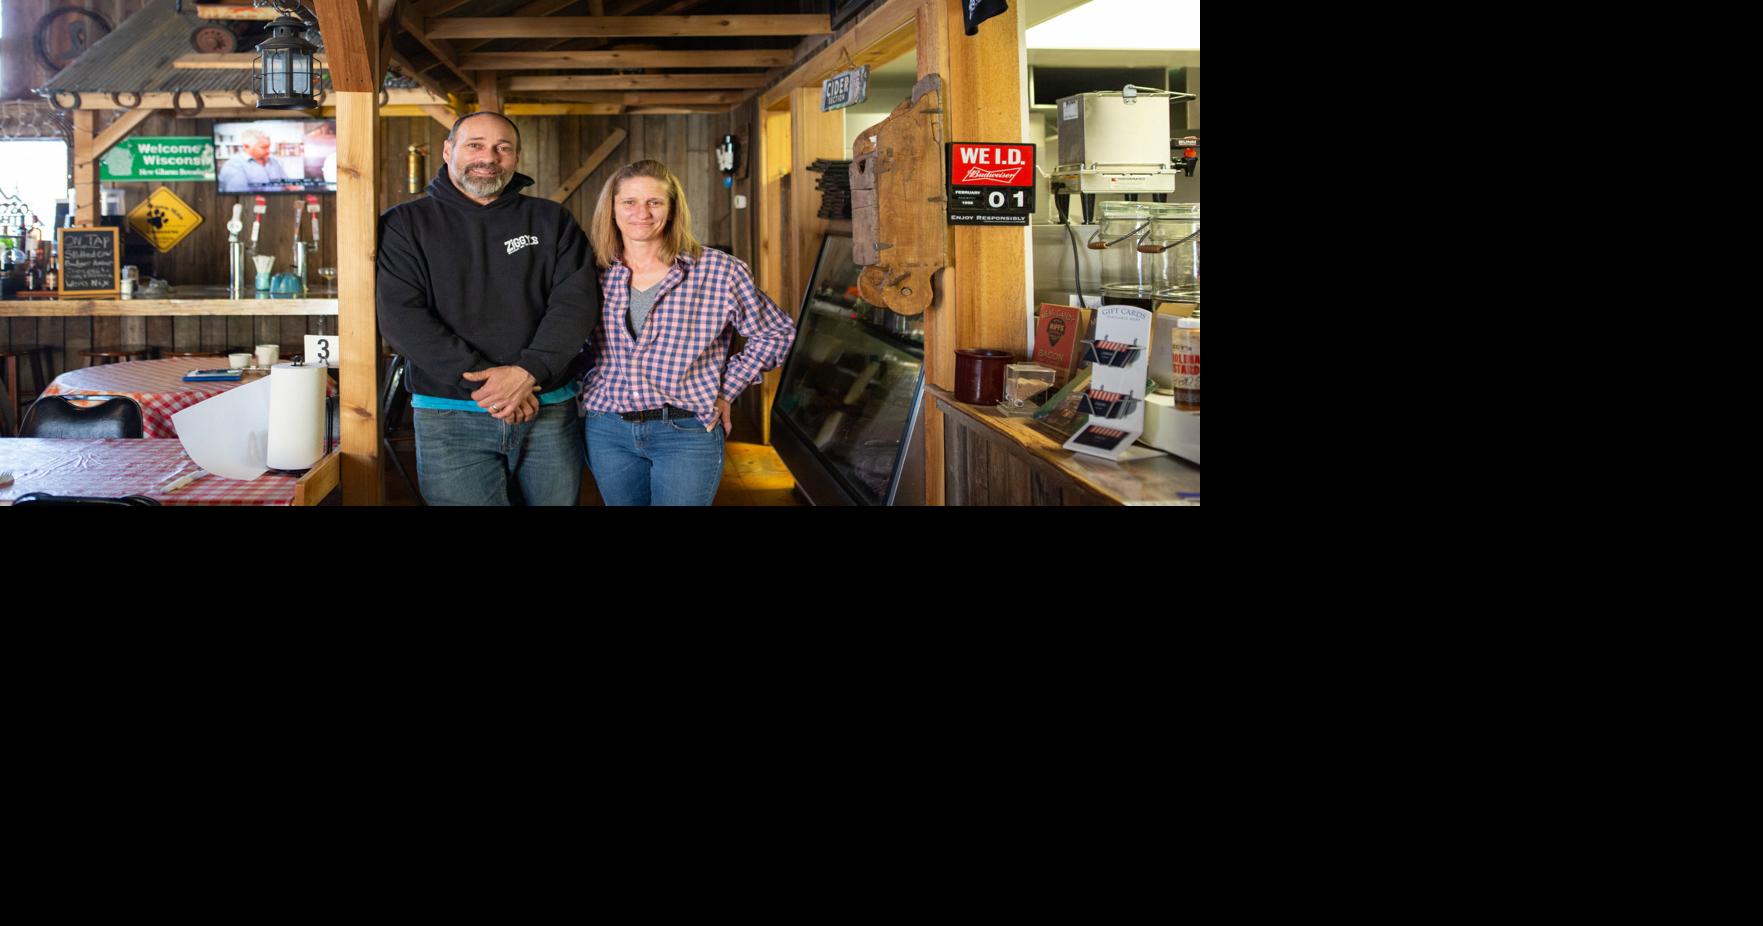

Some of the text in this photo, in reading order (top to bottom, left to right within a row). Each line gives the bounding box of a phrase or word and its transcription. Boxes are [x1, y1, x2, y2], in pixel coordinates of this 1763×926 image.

[827, 76, 849, 97] CIDER
[138, 143, 200, 154] Welcome
[960, 147, 1026, 165] WE I.D.
[968, 169, 1015, 179] Budweiser
[84, 234, 110, 249] TAP
[1101, 307, 1146, 320] GIFT CARDS
[317, 338, 330, 360] 3
